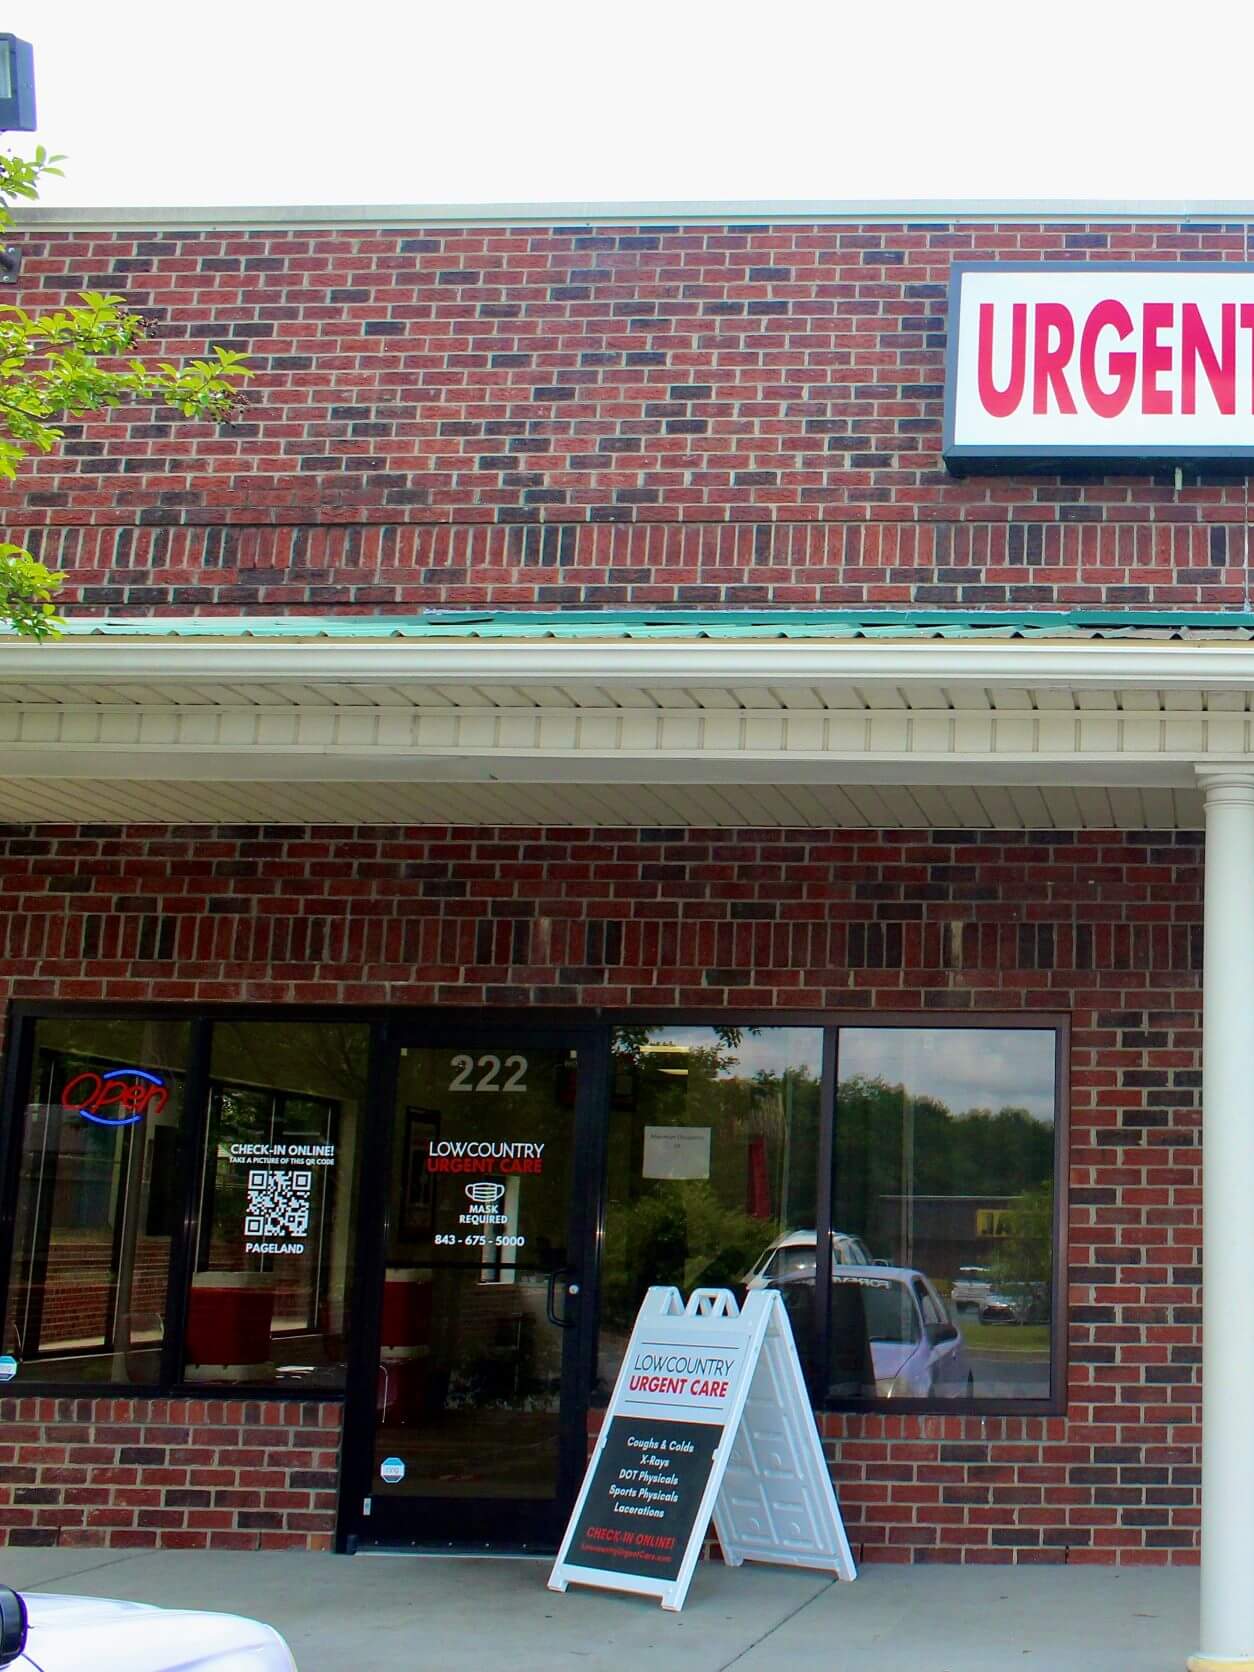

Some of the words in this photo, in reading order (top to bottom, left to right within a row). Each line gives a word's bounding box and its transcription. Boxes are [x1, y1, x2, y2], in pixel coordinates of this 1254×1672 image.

[448, 1054, 528, 1092] 222
[230, 1144, 287, 1156] CHECK-IN
[288, 1145, 335, 1157] ONLINE!
[429, 1142, 545, 1159] LOWCOUNTRY
[426, 1158, 495, 1173] URGENT
[500, 1158, 543, 1174] CARE
[469, 1205, 499, 1214] MASK
[459, 1215, 508, 1225] REQUIRED
[245, 1243, 305, 1254] PAGELAND
[434, 1234, 456, 1245] 843
[464, 1235, 486, 1246] 675
[495, 1236, 525, 1247] 5000
[634, 1355, 735, 1376] LOWCOUNTRY
[629, 1376, 688, 1394] URGENT
[690, 1380, 729, 1397] CARE
[627, 1436, 659, 1450] Coughs
[660, 1440, 667, 1450] &
[669, 1441, 694, 1453] Colds
[640, 1454, 670, 1469] X-Rays
[619, 1469, 638, 1480] DOT
[639, 1471, 679, 1485] Physicals
[609, 1484, 637, 1498] Sports
[638, 1488, 679, 1502] Physicals
[614, 1502, 665, 1518] Lacerations
